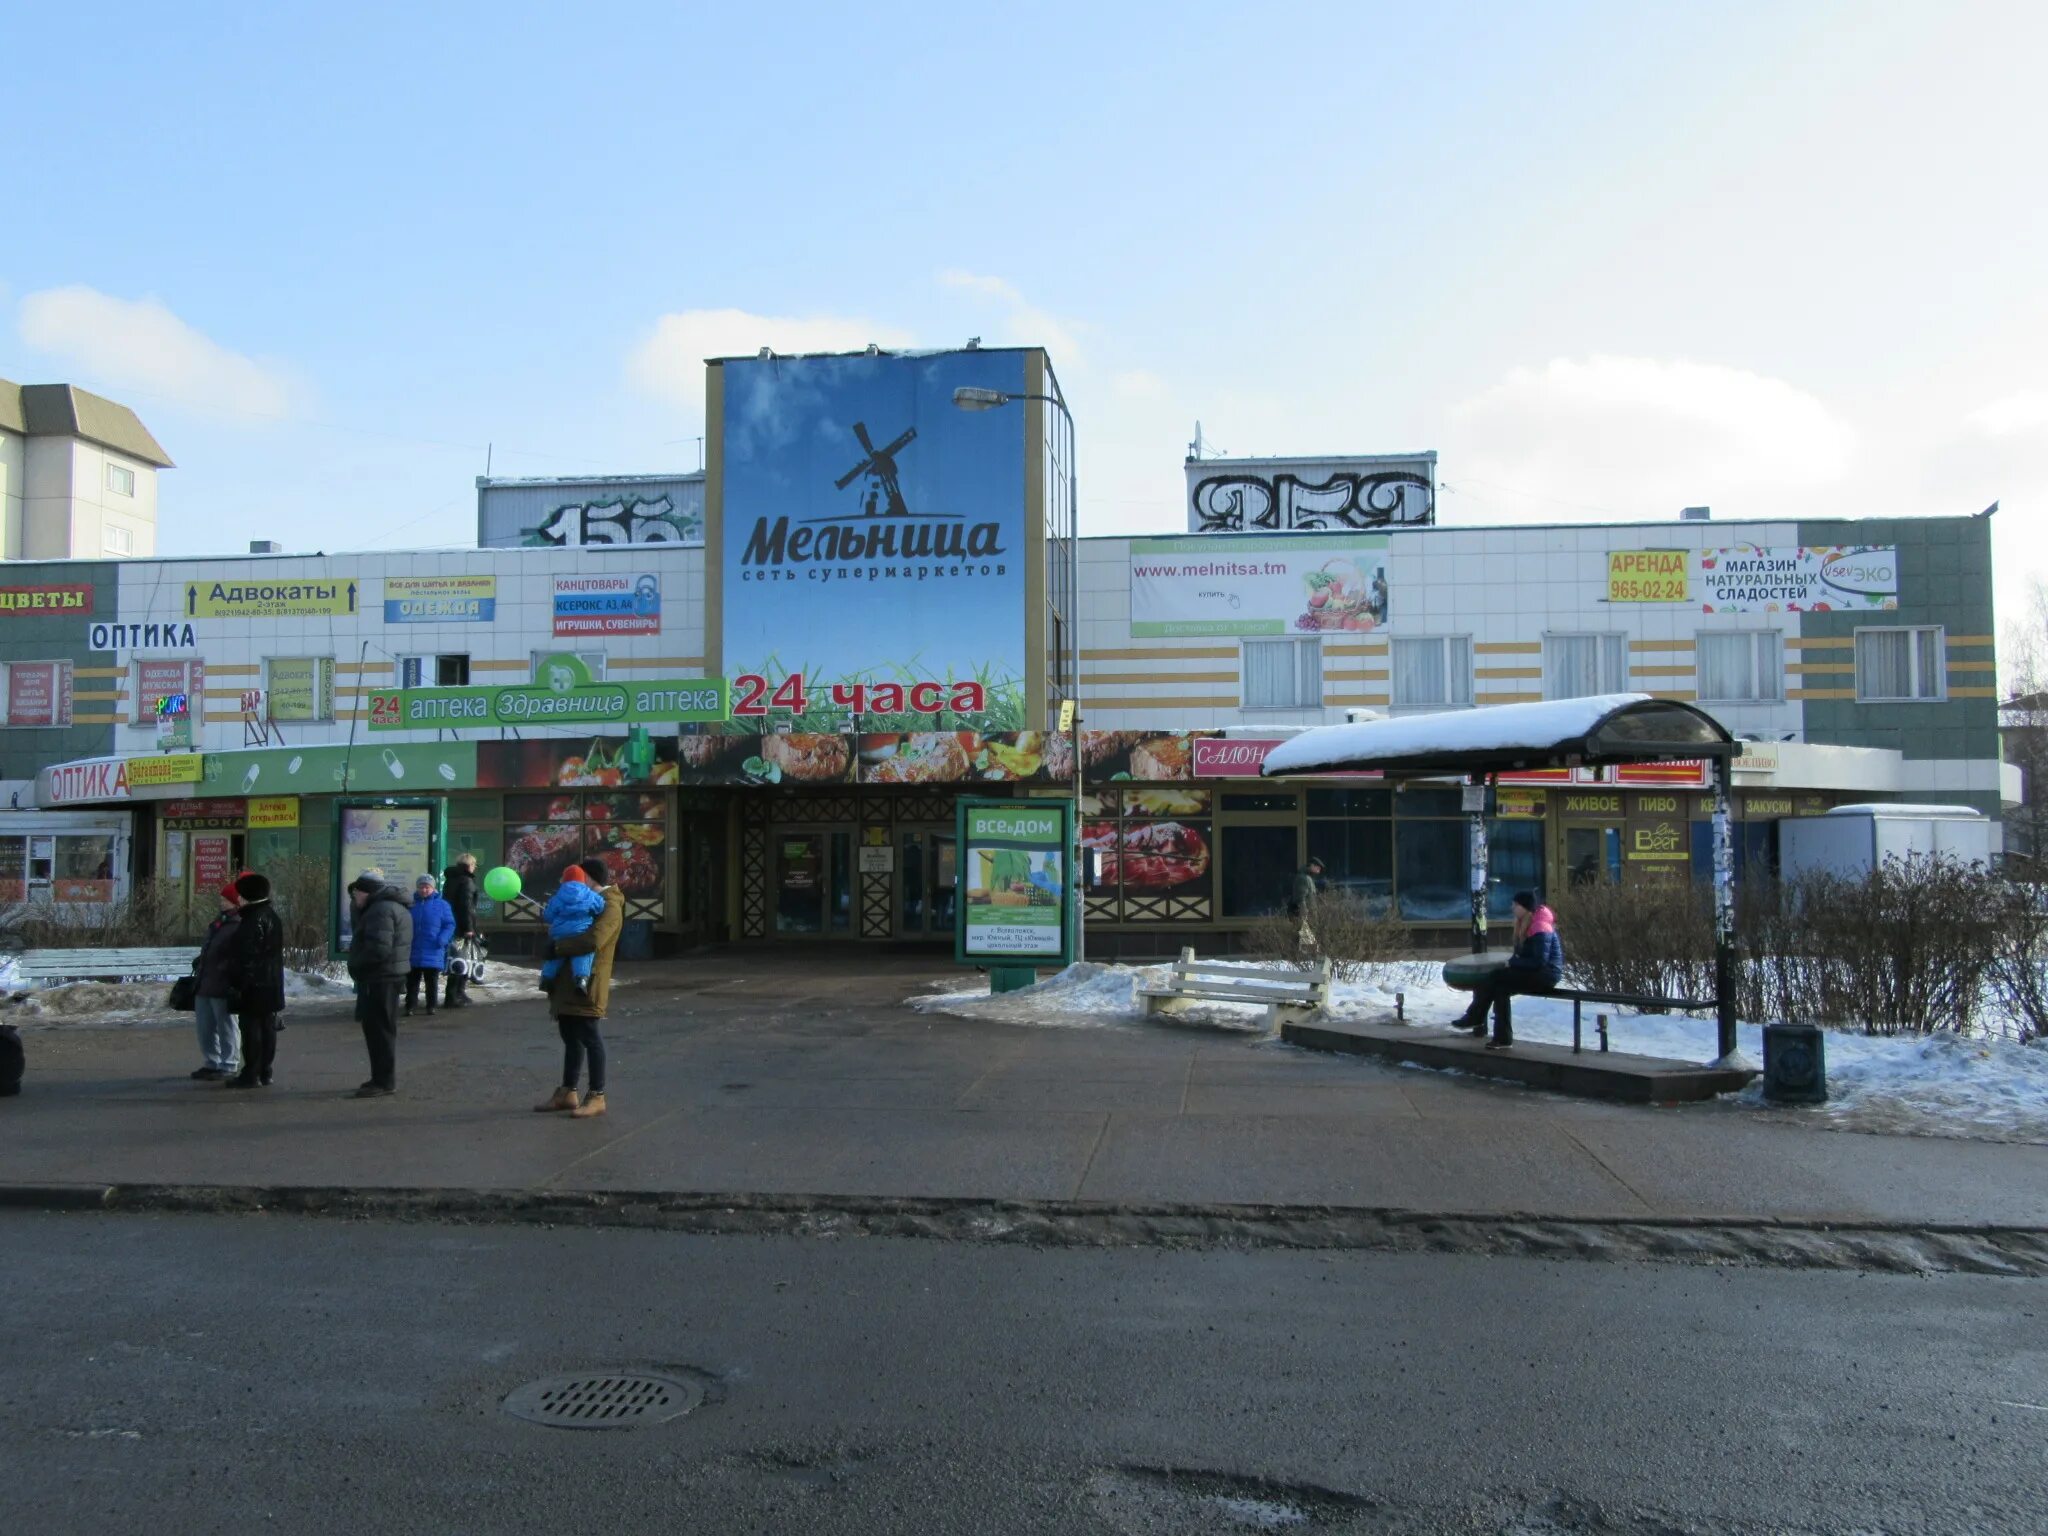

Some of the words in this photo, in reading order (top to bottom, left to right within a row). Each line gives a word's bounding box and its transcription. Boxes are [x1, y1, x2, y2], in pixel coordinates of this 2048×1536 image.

[741, 516, 1006, 565] Мельница
[742, 568, 796, 582] сеть
[808, 563, 1006, 583] супермаркетов
[1133, 561, 1287, 577] www.melnitsa.tm
[1611, 554, 1684, 576] АРЕНДА
[1725, 560, 1797, 573] МАГАЗИН
[556, 579, 629, 592] КАНЦТОВАРЫ
[1611, 580, 1684, 599] 965-02-24
[1705, 573, 1818, 587] НАТУРАЛЬНЫХ
[0, 591, 85, 611] ЦВЕТЫ
[209, 583, 337, 604] Адвокаты
[1716, 586, 1808, 602] СЛАДОСТЕЙ
[401, 600, 480, 616] ОДЕЖДА
[556, 600, 603, 611] КСЕРОКС
[556, 620, 605, 631] ИГРУШКИ,
[606, 618, 657, 630] СУВЕНИРЫ
[92, 623, 196, 649] ОПТИКА
[145, 669, 181, 679] ОДЕЖДА
[143, 681, 184, 690] МУЖСКАЯ
[733, 673, 808, 717] 24
[831, 680, 986, 715] часа
[240, 691, 261, 712] БАР
[371, 696, 400, 715] 24
[410, 696, 488, 719] аптека
[498, 694, 625, 718] Здравница
[635, 688, 719, 713] аптека
[1197, 745, 1265, 765] САЛОН
[51, 763, 132, 801] ОПТИКА
[258, 802, 287, 812] Аптека
[1565, 796, 1620, 812] ЖИВОЕ
[1638, 797, 1677, 812] ПИВО
[1746, 799, 1793, 813] ЗАКУСКИ
[250, 812, 297, 824] открылась!
[1635, 829, 1680, 850] Beer
